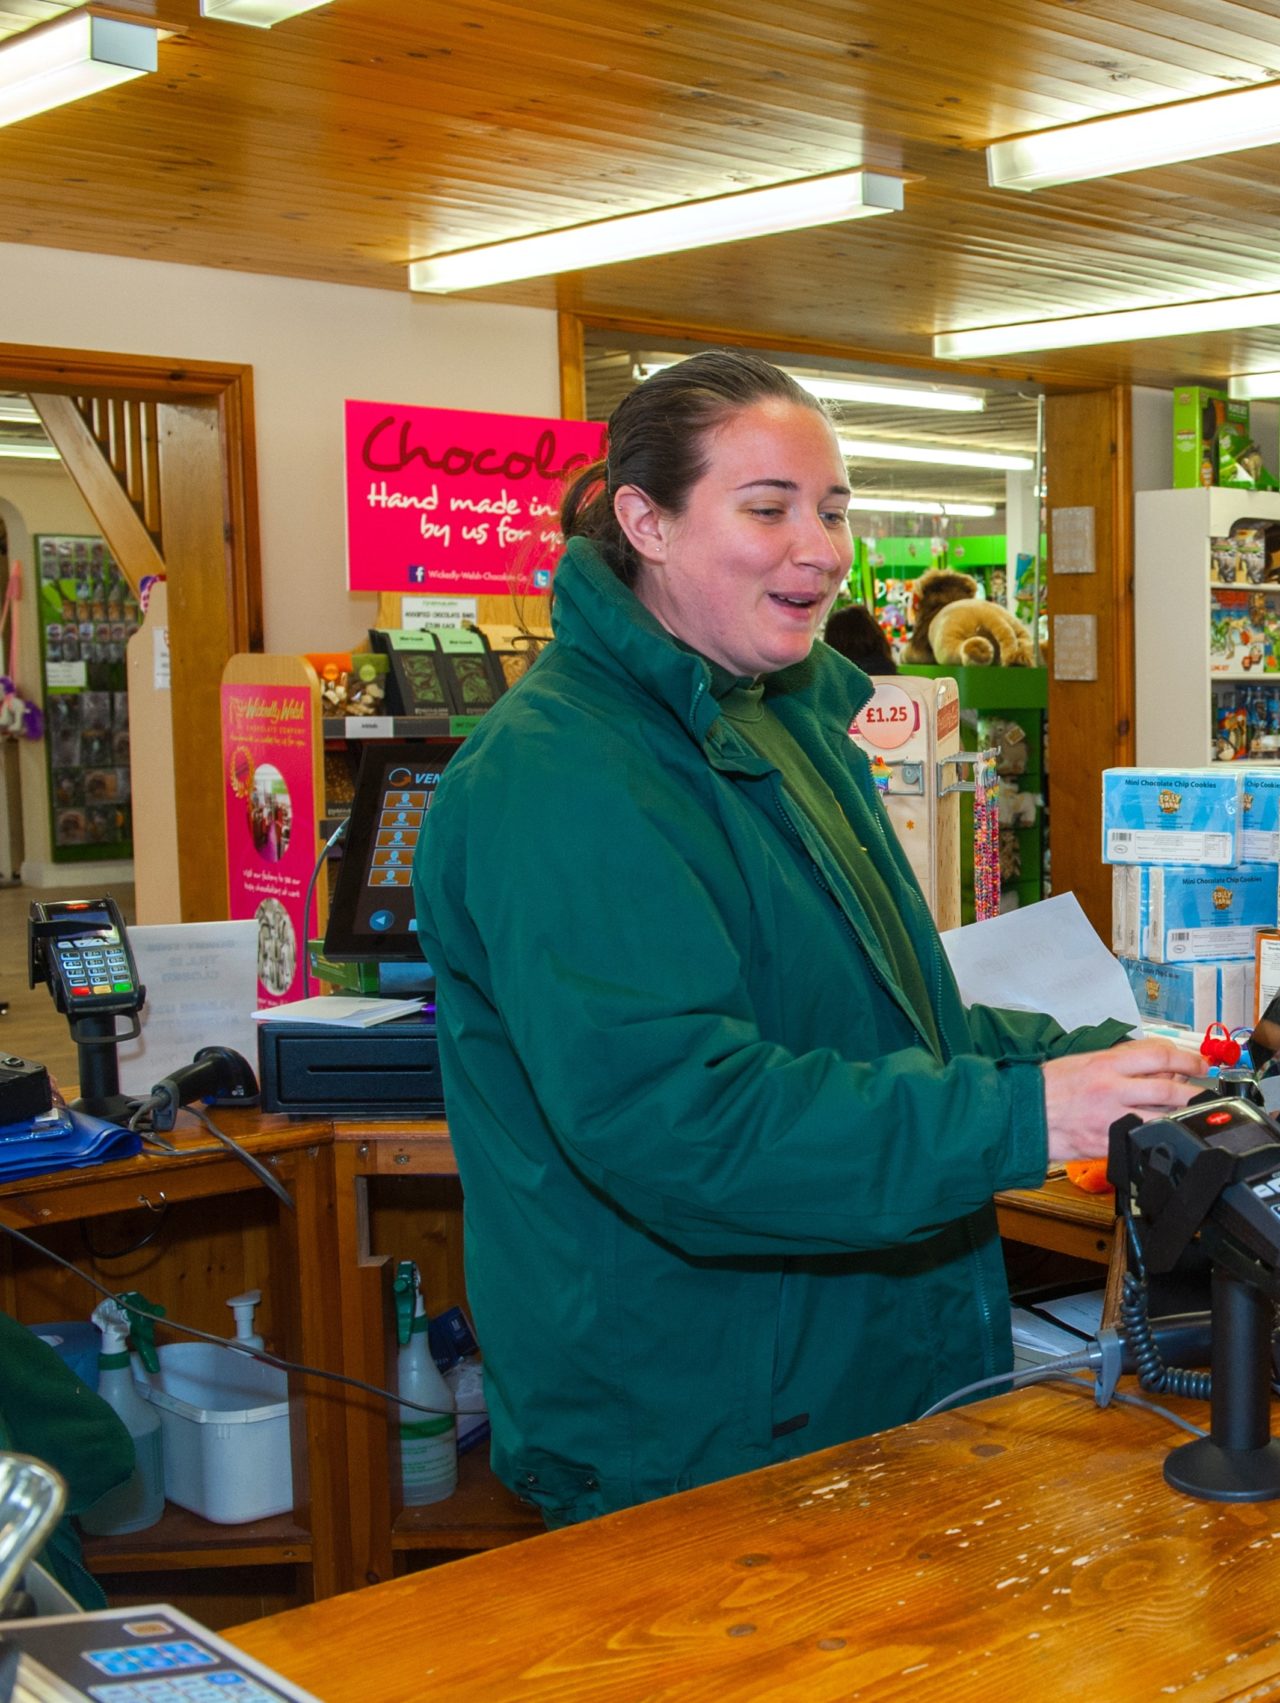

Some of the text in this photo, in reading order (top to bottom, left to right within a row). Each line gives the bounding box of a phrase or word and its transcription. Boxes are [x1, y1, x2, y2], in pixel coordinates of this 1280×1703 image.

[362, 416, 608, 480] Chocola
[367, 481, 558, 517] Hand made in
[420, 514, 450, 548] by
[462, 522, 489, 545] us
[496, 516, 531, 548] for
[866, 706, 908, 723] £1.25
[1140, 779, 1173, 787] Chocolate
[1174, 780, 1189, 789] Chip
[1190, 781, 1217, 789] Cookies
[1197, 877, 1225, 885] Chocolate
[1226, 877, 1239, 885] Chip
